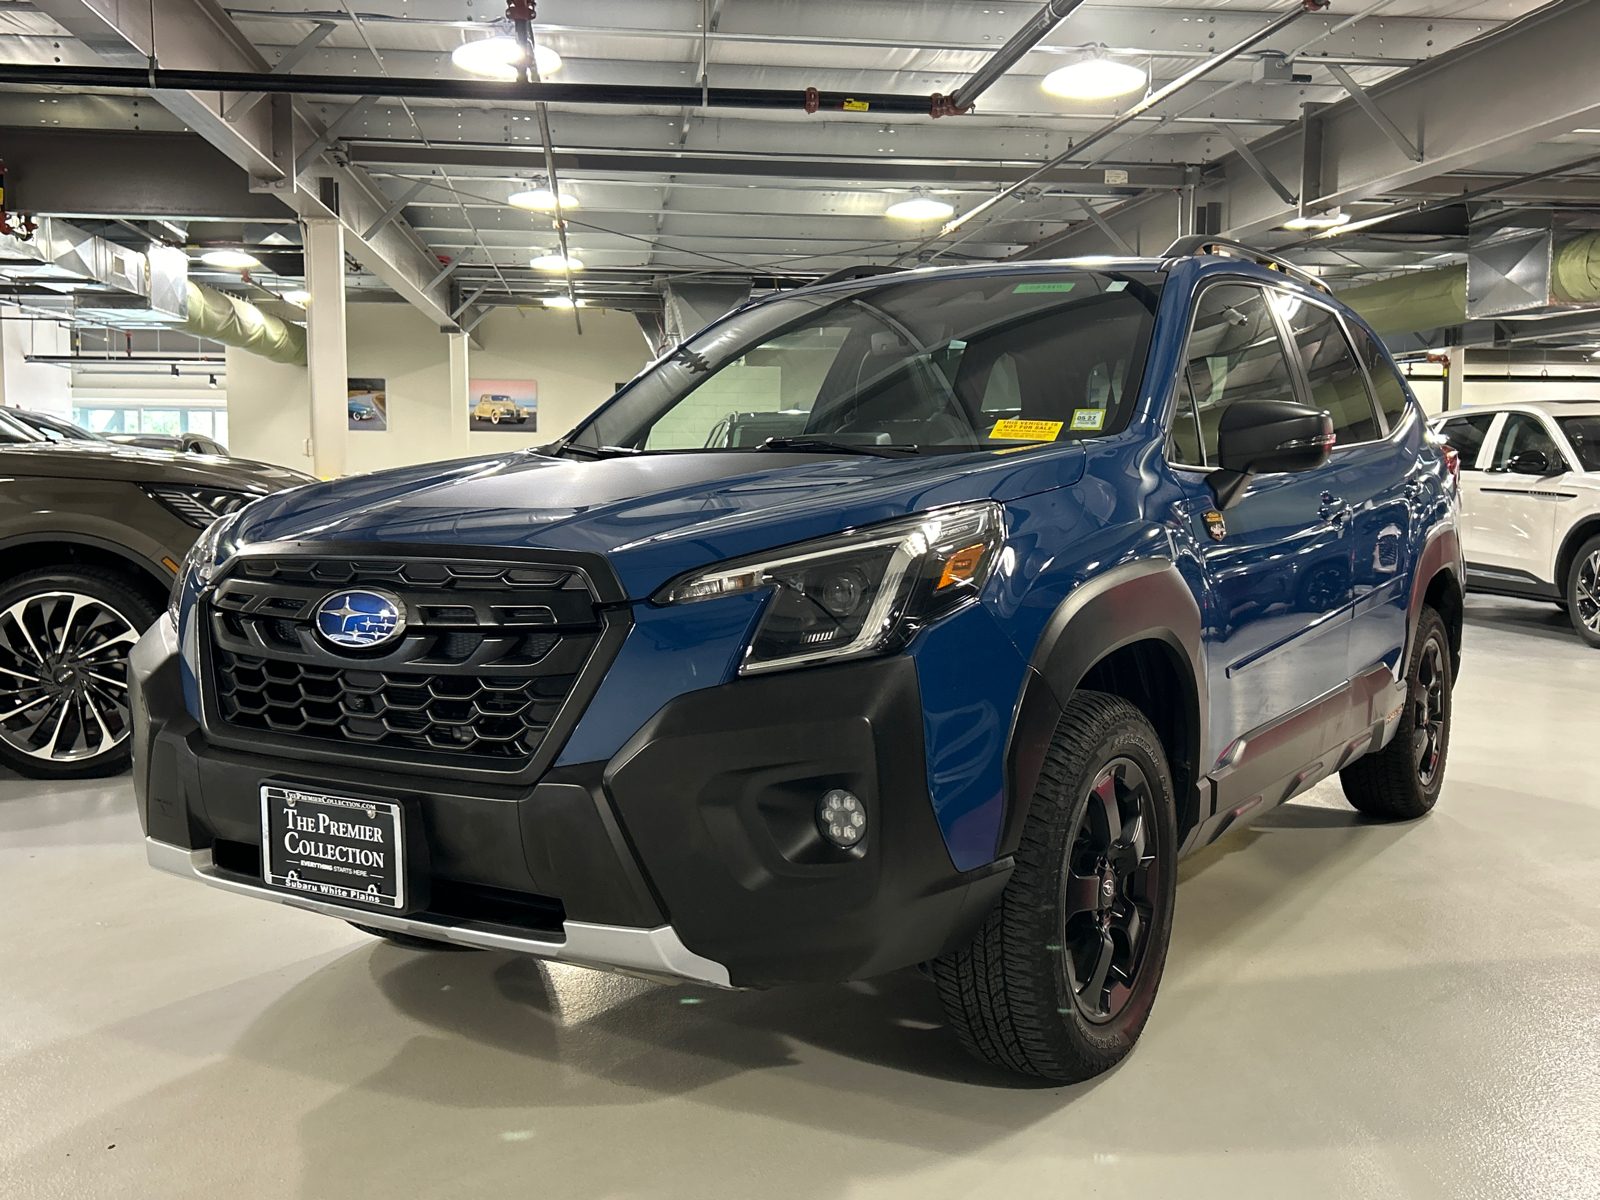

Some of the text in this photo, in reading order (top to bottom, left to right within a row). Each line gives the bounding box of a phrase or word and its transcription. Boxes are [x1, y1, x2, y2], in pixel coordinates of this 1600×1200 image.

[283, 808, 384, 844] THE PREMIER
[284, 831, 384, 869] COLLECTION
[300, 859, 333, 871] EVERYTHING
[333, 865, 353, 875] STARTS
[285, 878, 380, 904] Subaru White Plains
